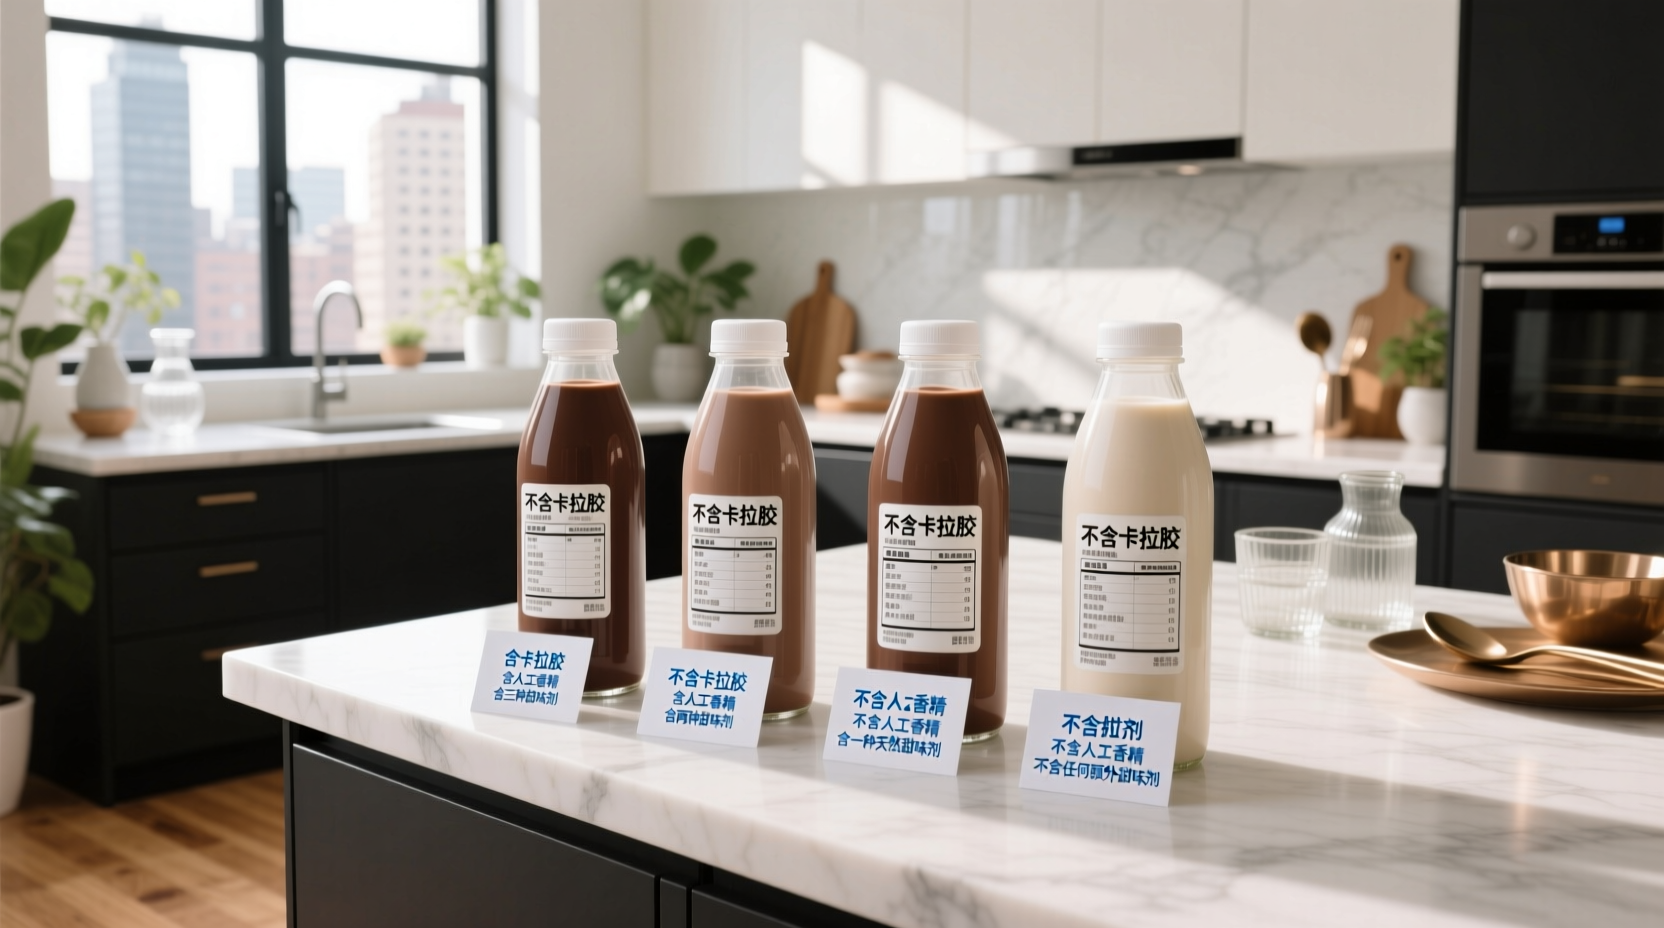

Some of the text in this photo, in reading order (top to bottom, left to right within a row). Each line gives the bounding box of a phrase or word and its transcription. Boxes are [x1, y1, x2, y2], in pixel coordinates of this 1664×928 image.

[525, 492, 605, 512] 不含卡拉胶
[693, 503, 777, 526] 不含卡拉胶
[884, 514, 977, 537] 不含卡拉胶
[1081, 525, 1181, 550] 不含卡拉胶
[505, 649, 565, 670] 含卡拉胶
[668, 668, 747, 692] 不含卡拉胶
